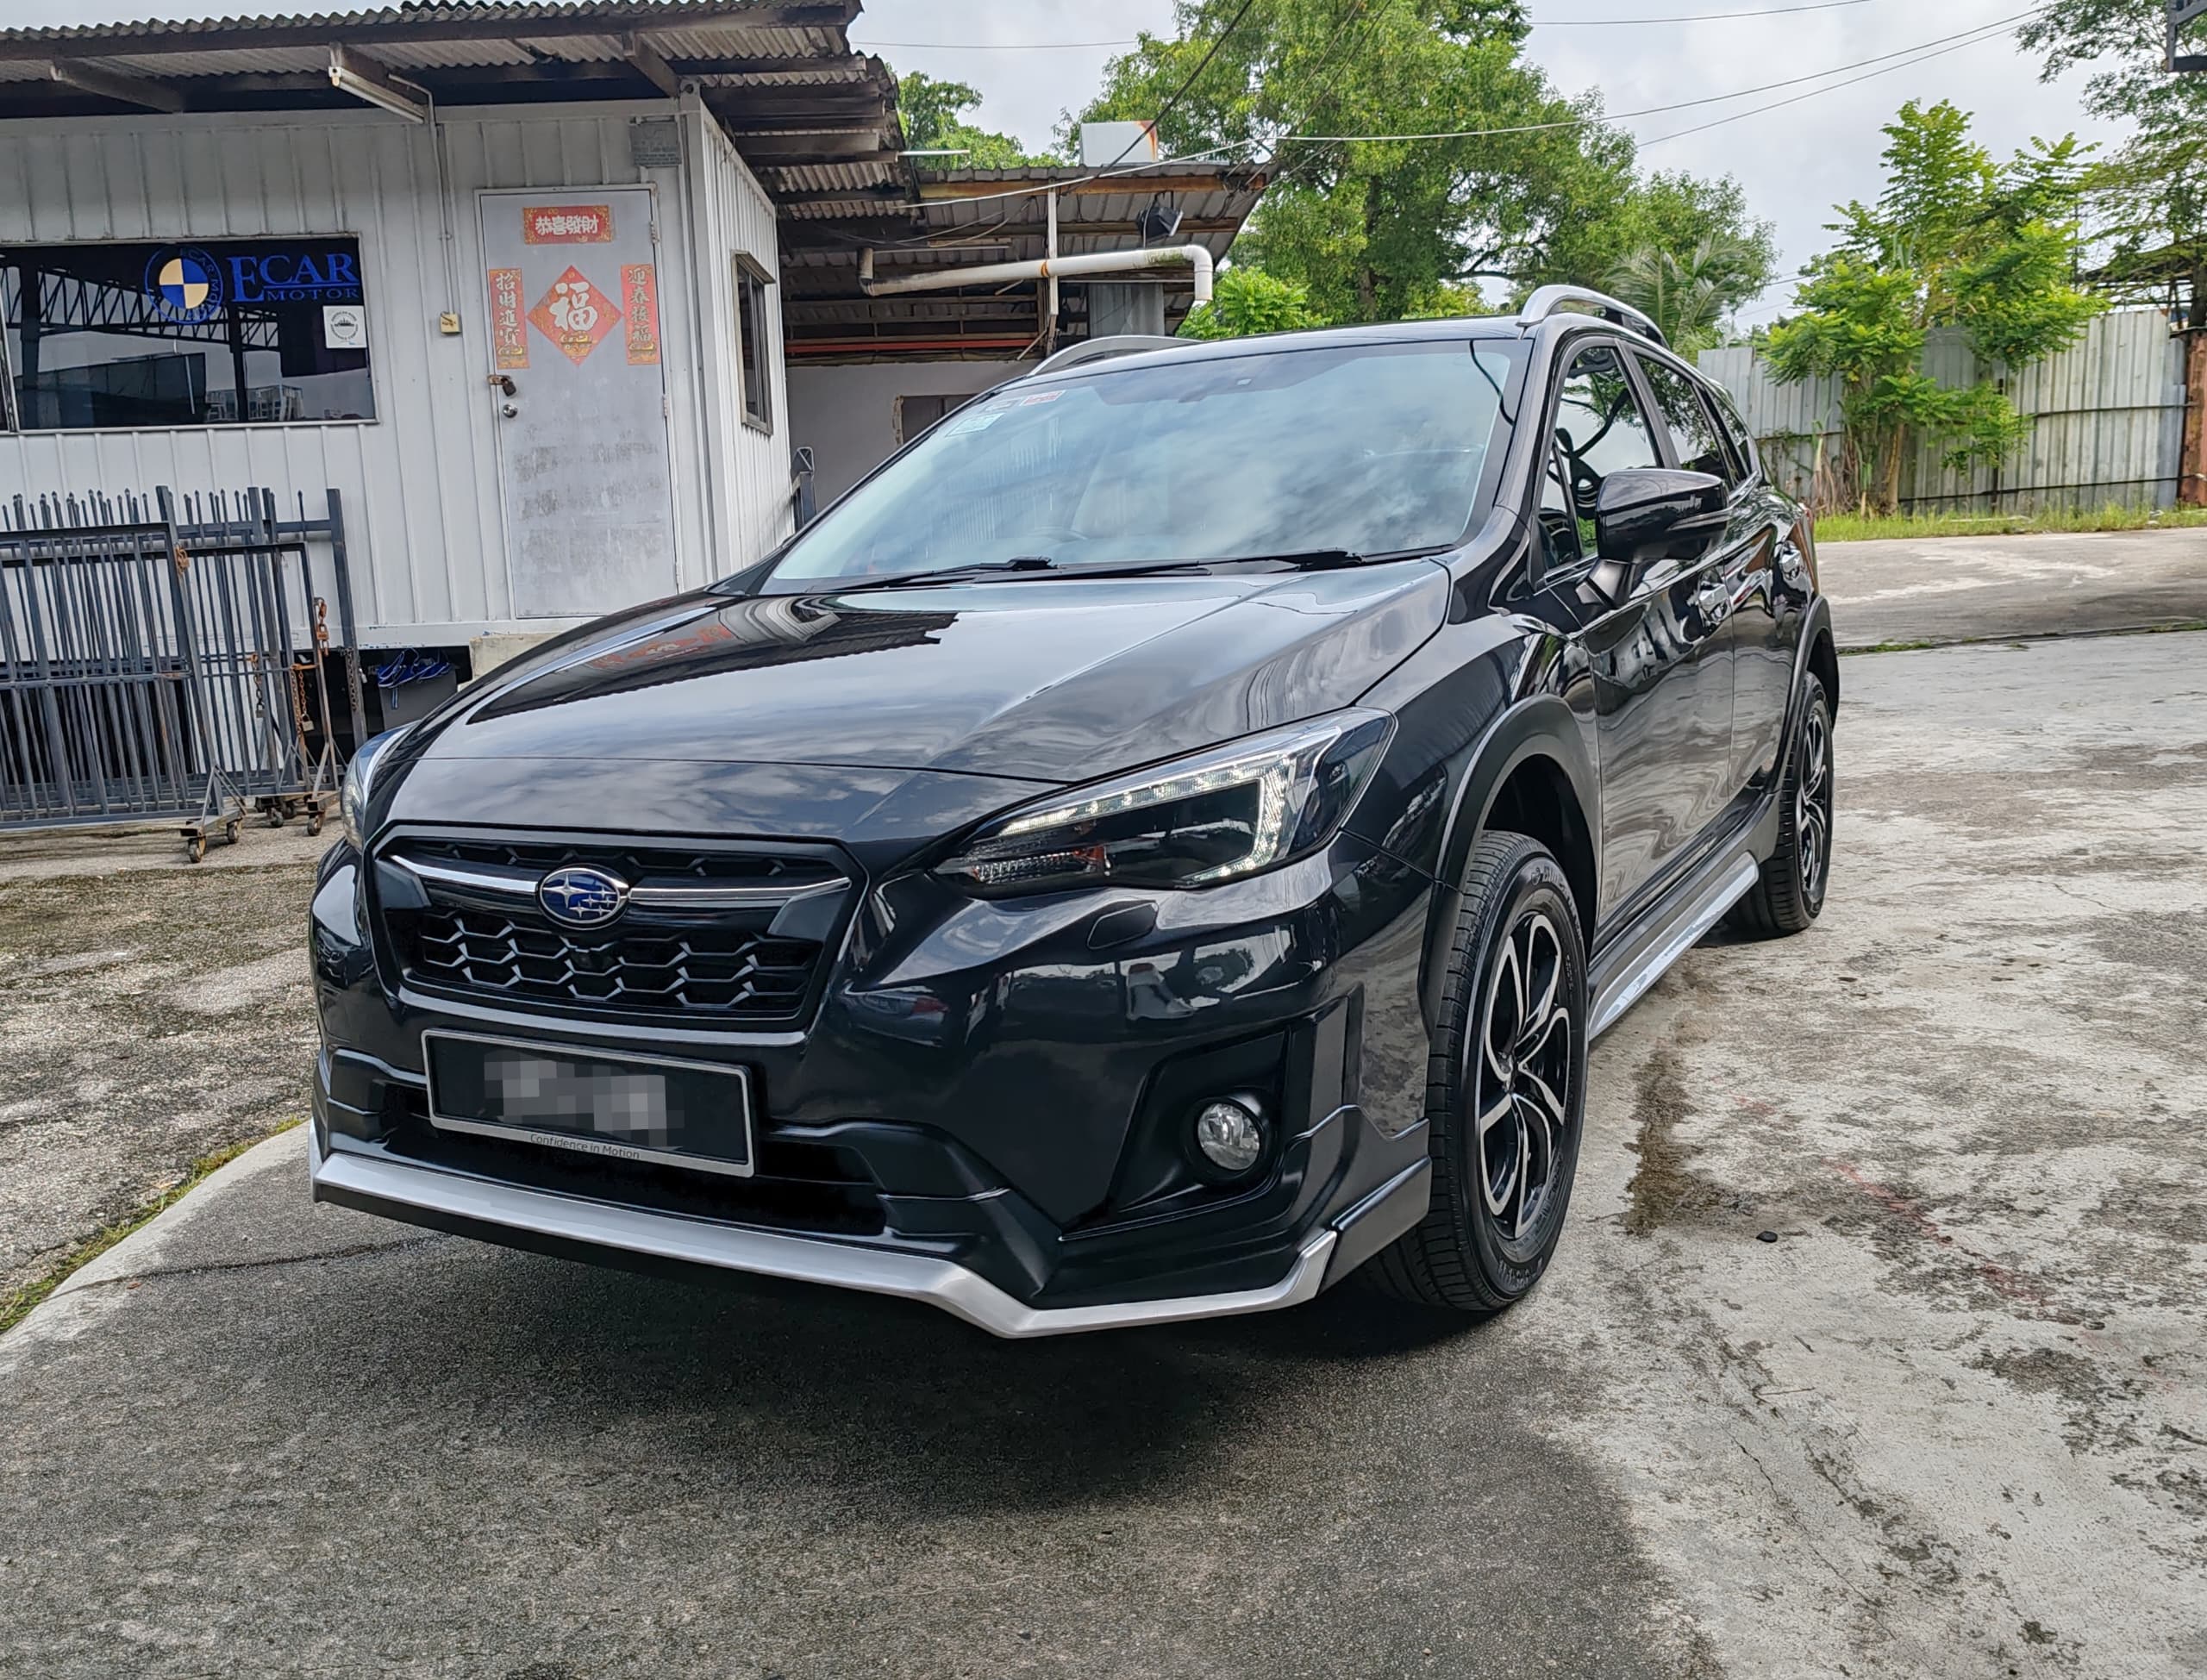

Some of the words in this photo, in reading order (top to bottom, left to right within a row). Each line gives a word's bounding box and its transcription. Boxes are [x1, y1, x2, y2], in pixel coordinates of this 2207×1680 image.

[535, 215, 599, 236] 恭喜發財
[226, 253, 359, 303] ECAR
[266, 288, 359, 302] MOTOR
[548, 282, 598, 332] 福
[530, 1134, 588, 1152] Confidence
[590, 1143, 600, 1153] in
[603, 1144, 641, 1159] Motion
